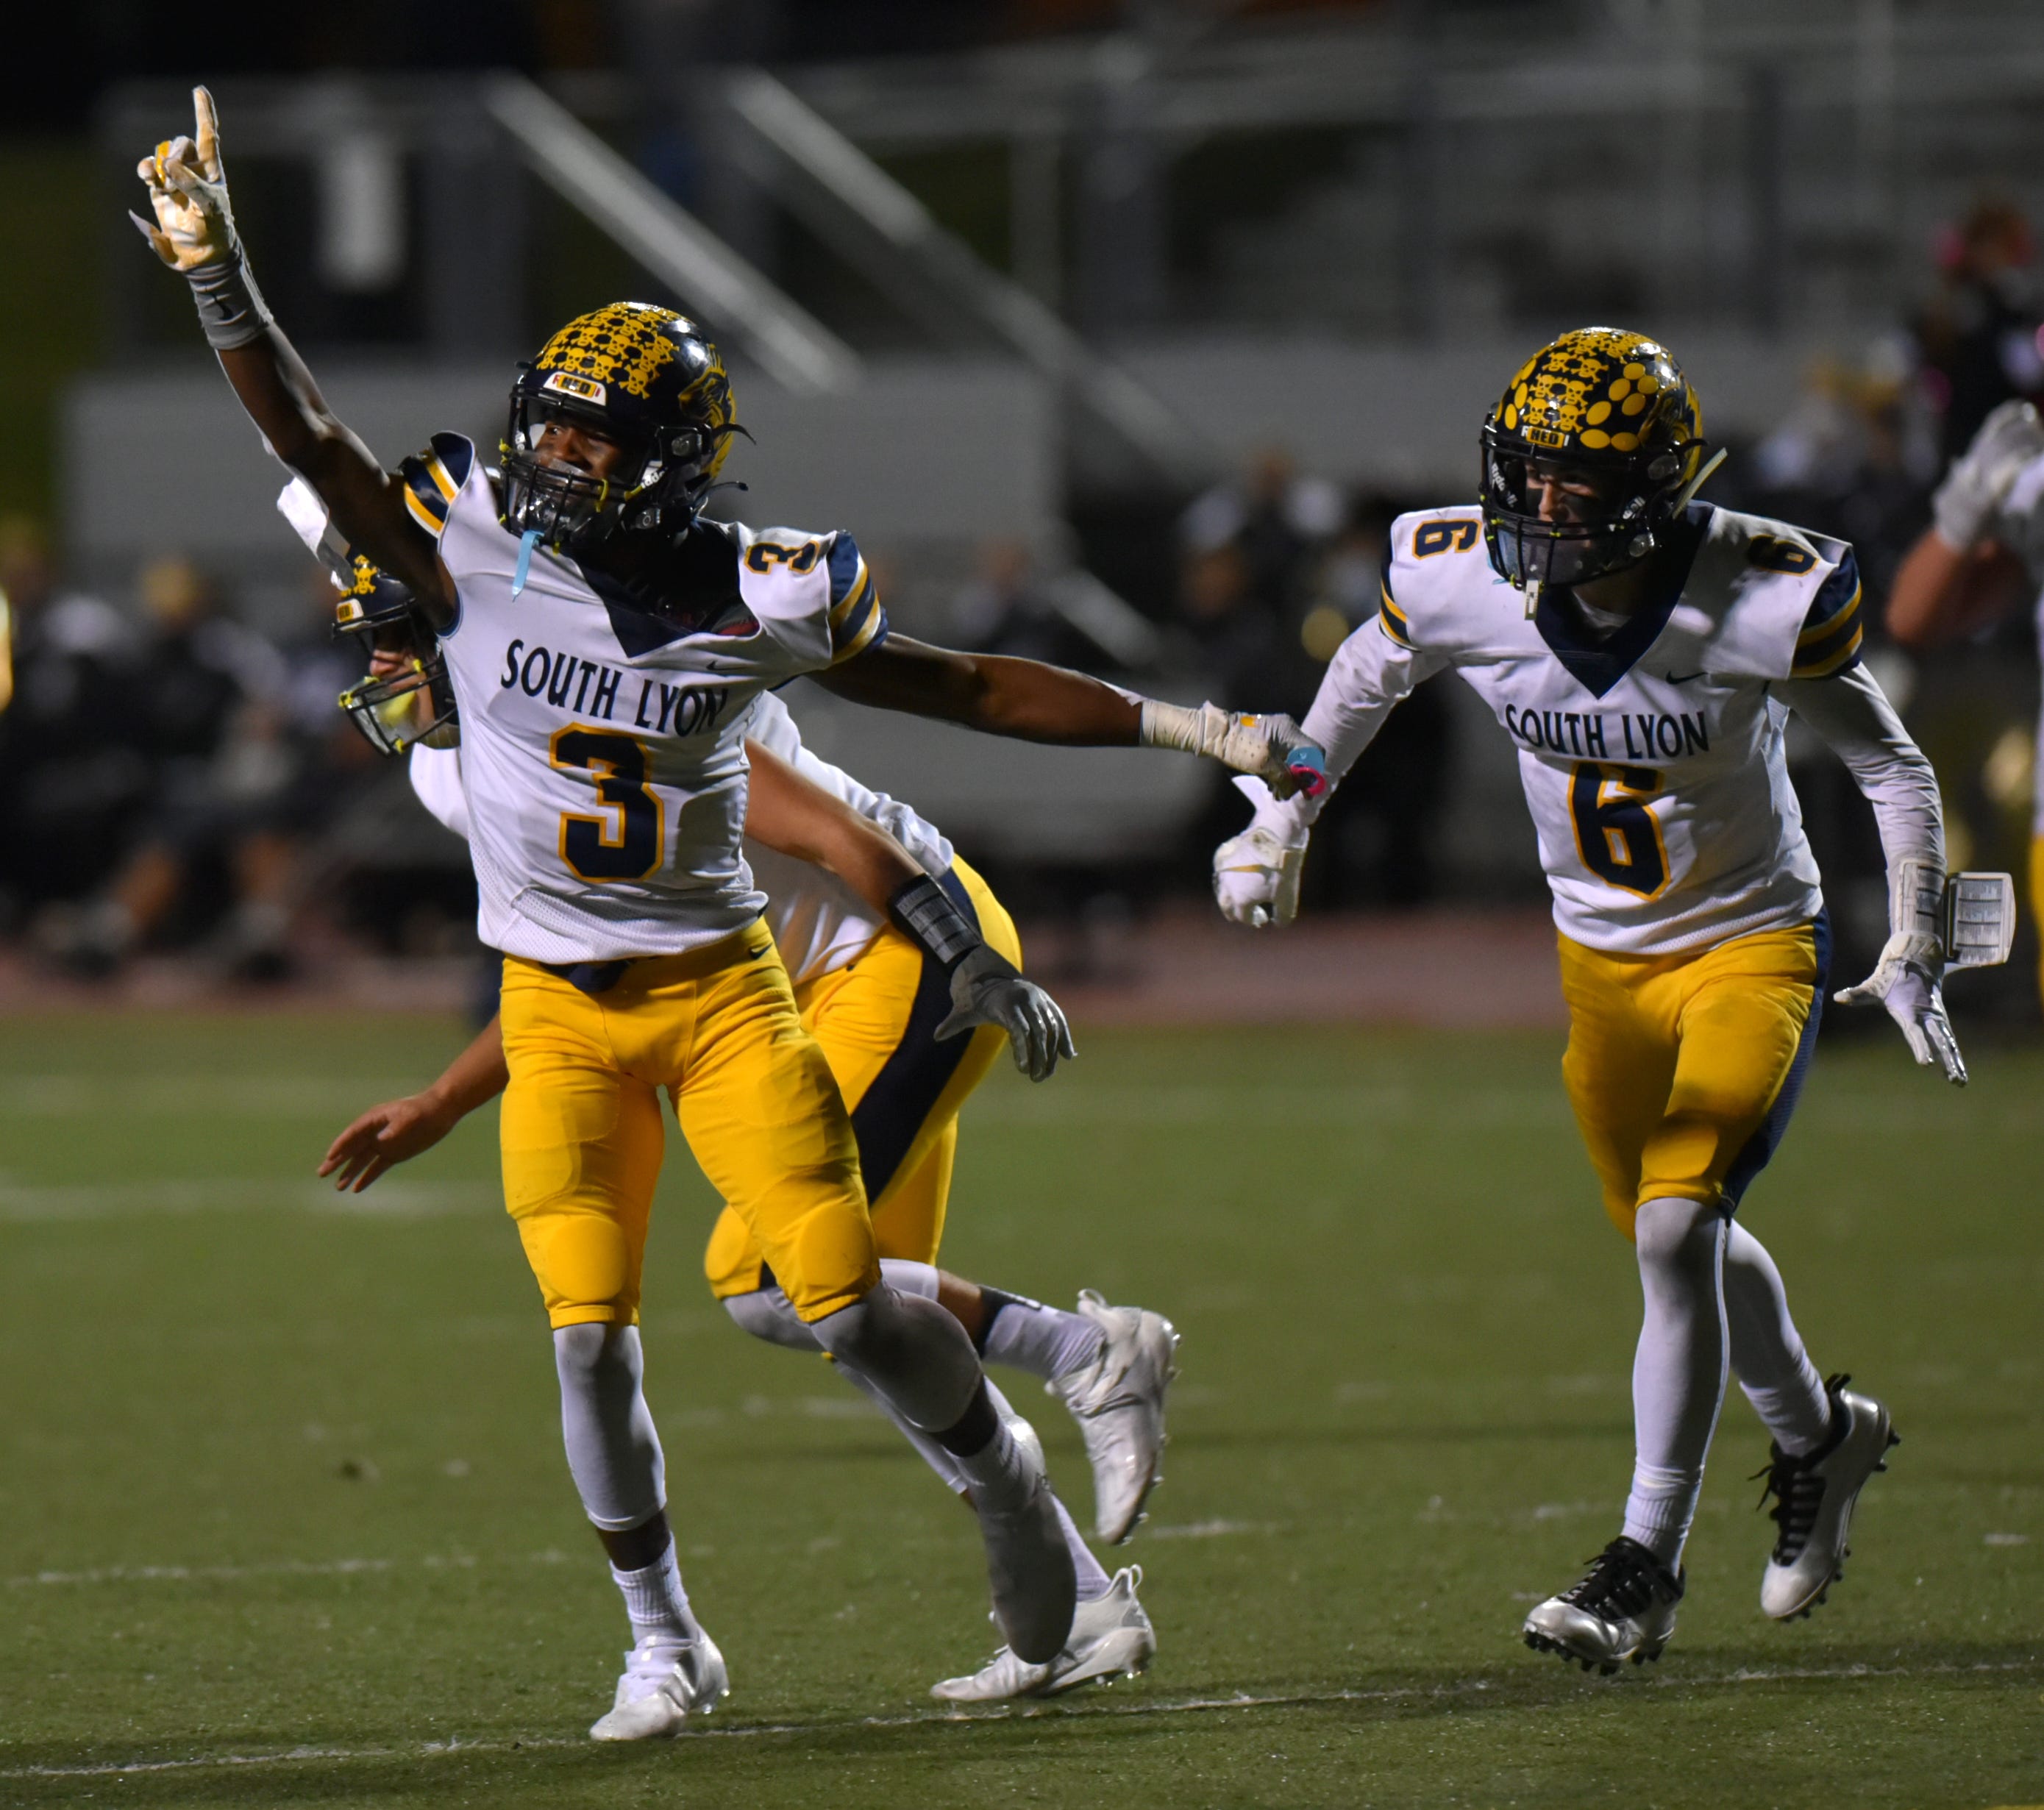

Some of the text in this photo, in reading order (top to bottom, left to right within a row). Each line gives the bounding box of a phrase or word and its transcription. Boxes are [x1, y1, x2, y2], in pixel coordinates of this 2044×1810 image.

[744, 540, 820, 575] 3
[1411, 518, 1483, 560] 6
[1748, 533, 1821, 577] 6
[501, 638, 729, 737] SOUTH LYON
[1506, 703, 1709, 760] SOUTH LYON
[549, 721, 665, 884] 3
[1567, 760, 1672, 902] 6
